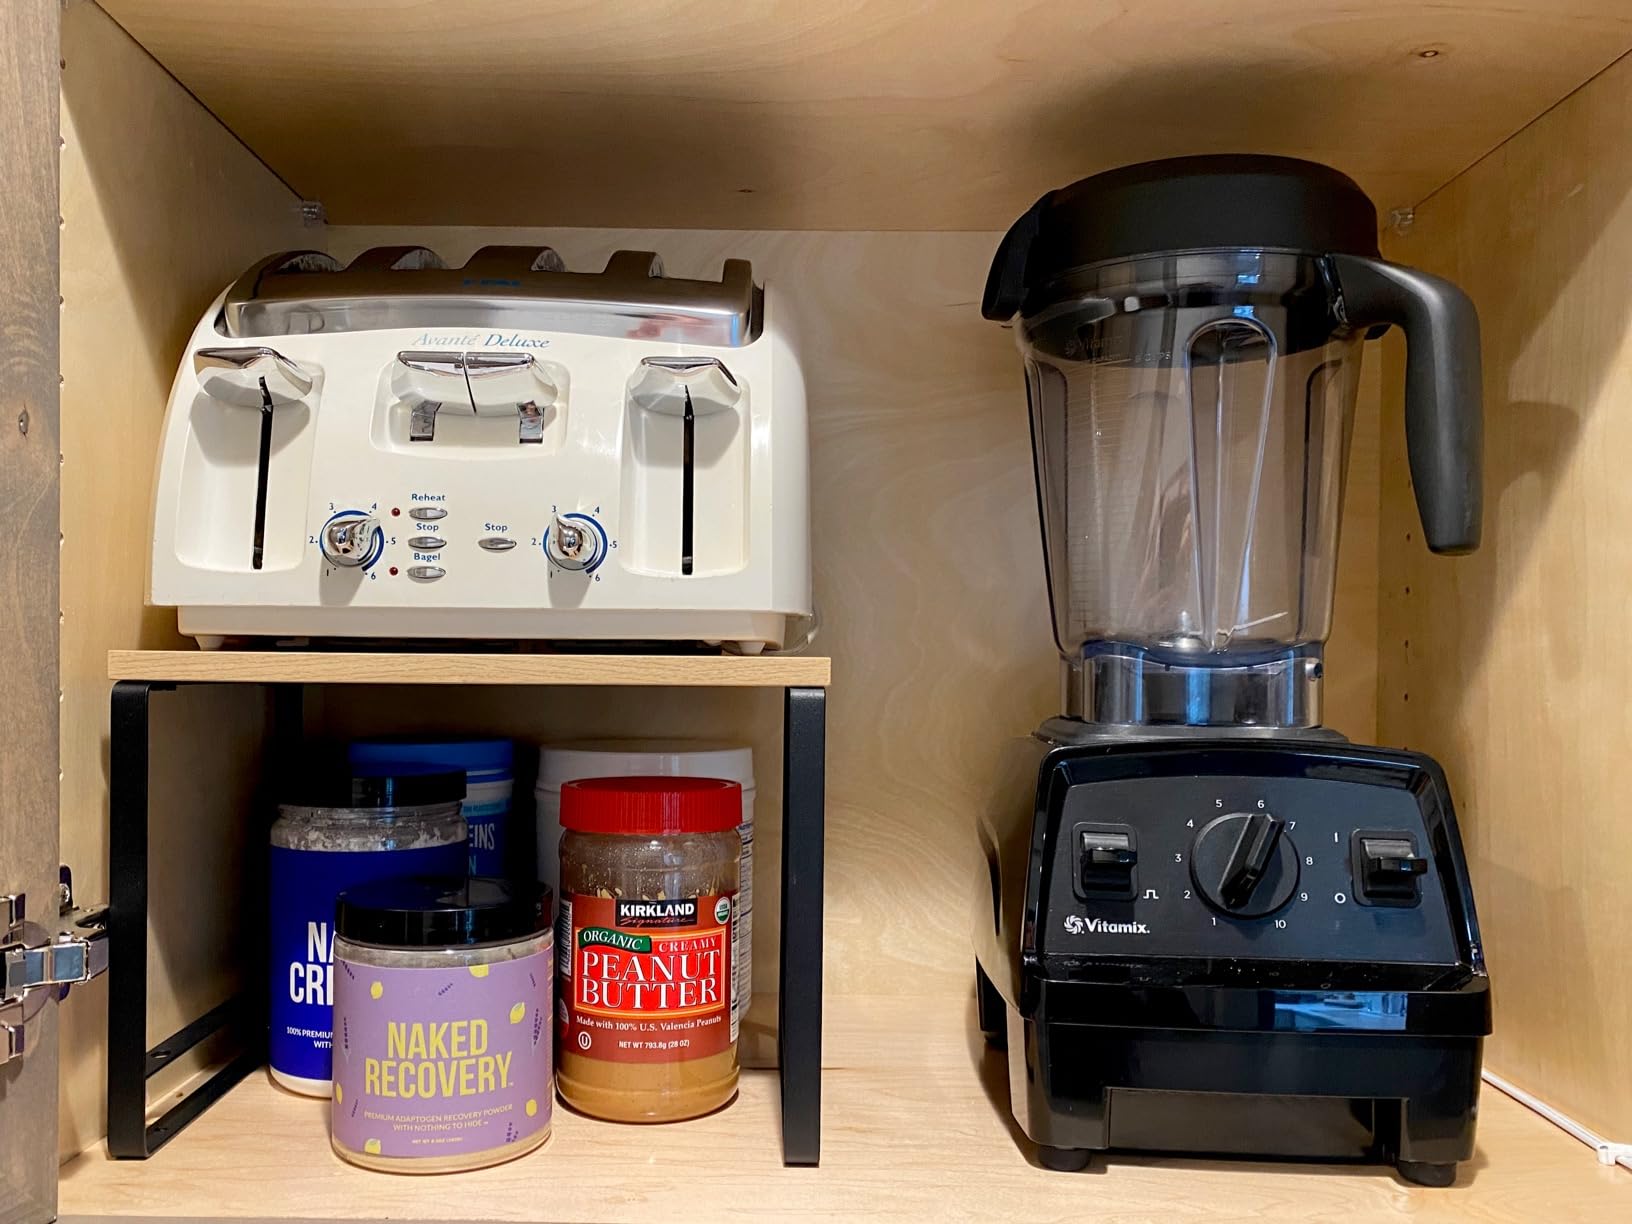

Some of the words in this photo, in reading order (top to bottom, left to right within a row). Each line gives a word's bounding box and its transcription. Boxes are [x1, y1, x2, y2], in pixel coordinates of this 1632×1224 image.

[411, 333, 482, 346] Avanté
[484, 333, 550, 348] Deluxe
[411, 493, 446, 502] Reheat
[416, 523, 439, 532] Stop
[484, 523, 508, 532] Stop
[413, 553, 441, 562] Bagel
[1216, 800, 1222, 808] 5
[1257, 800, 1265, 809] 6
[1186, 820, 1194, 829] 4
[1290, 822, 1296, 830] 7
[1175, 854, 1182, 863] 3
[1306, 857, 1313, 866] 8
[1184, 890, 1191, 899] 2
[1301, 893, 1308, 902] 9
[621, 903, 694, 917] KIRKLAND
[1274, 920, 1286, 929] 10
[584, 931, 643, 950] ORGANIC
[658, 937, 717, 953] CREAMY
[582, 950, 720, 981] PEANUT
[582, 977, 717, 1009] BUTTER
[576, 1015, 594, 1027] Made
[596, 1020, 613, 1030] with
[616, 1022, 637, 1031] 100%
[640, 1024, 657, 1032] U.S.
[660, 1022, 695, 1031] Valencia
[697, 1015, 721, 1027] Peanuts
[287, 1026, 301, 1036] 100%
[388, 1019, 488, 1059] NAKED
[619, 1040, 630, 1049] NET
[632, 1041, 643, 1049] WT
[680, 1040, 690, 1048] OZ)
[365, 1051, 512, 1099] RECOVERY
[364, 1111, 394, 1123] PREMIUM
[396, 1114, 442, 1123] ADAPTOGEN
[444, 1111, 482, 1121] RECOVERY
[483, 1104, 513, 1117] POWDER
[393, 1124, 413, 1132] WITH
[415, 1123, 450, 1132] NOTHING
[452, 1122, 463, 1130] TO
